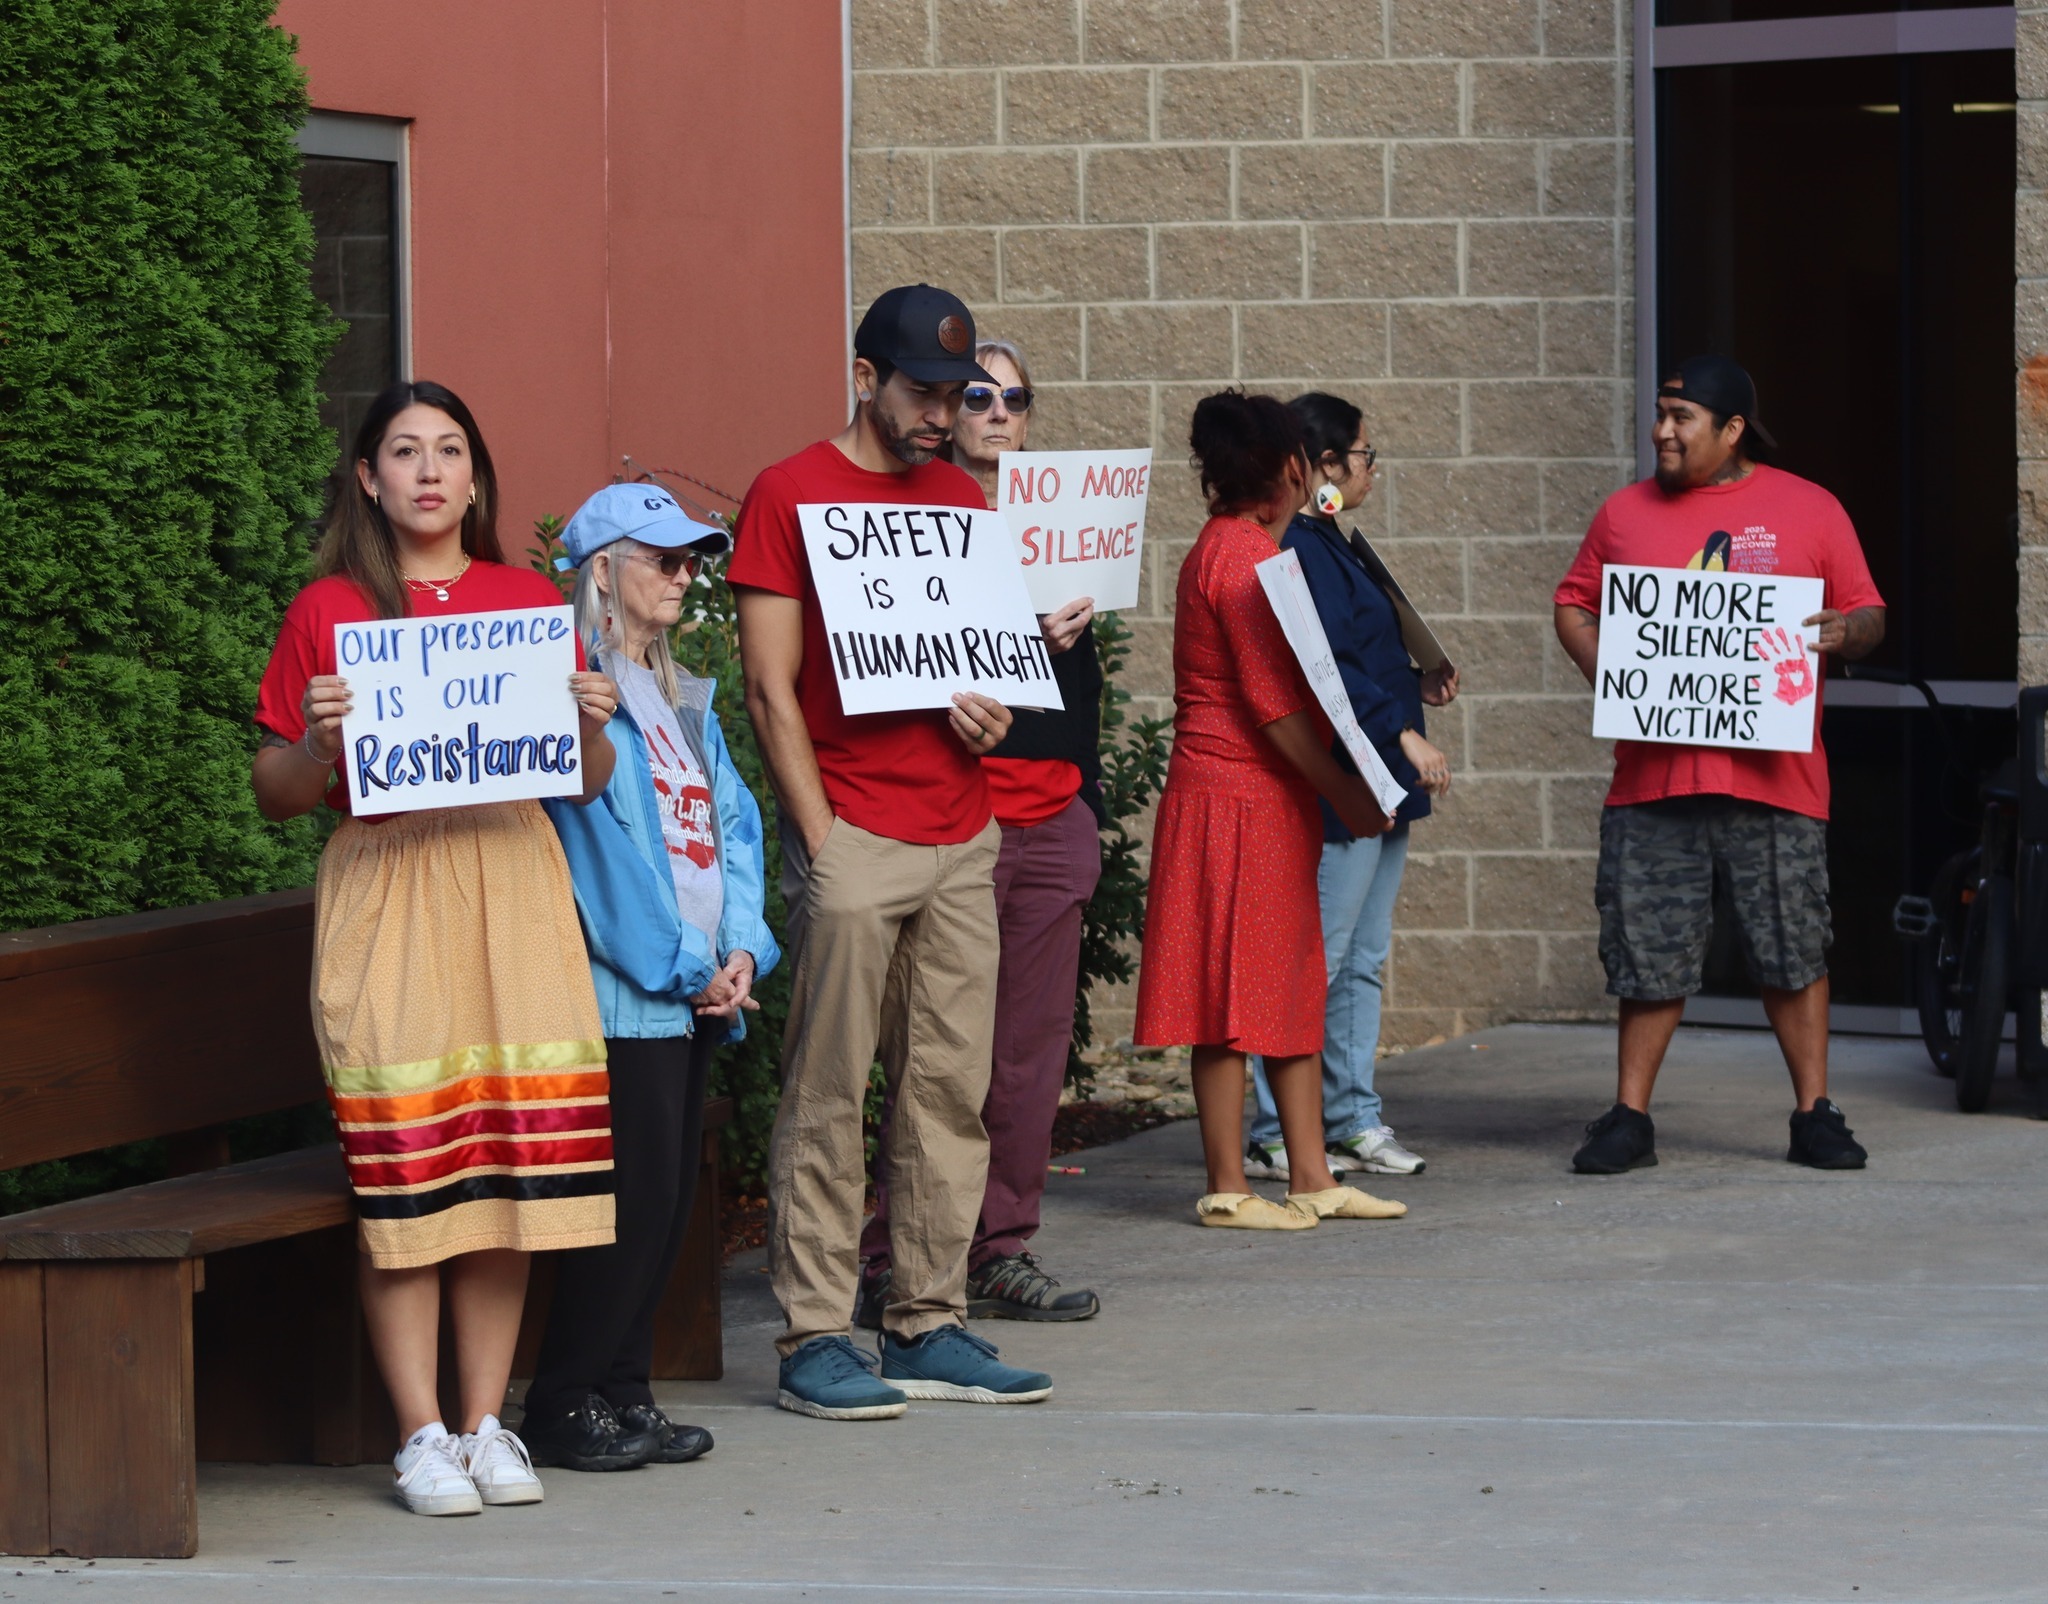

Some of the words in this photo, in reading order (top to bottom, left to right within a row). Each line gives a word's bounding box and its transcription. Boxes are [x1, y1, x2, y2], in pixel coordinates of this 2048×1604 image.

[1009, 466, 1060, 504] NO
[1081, 464, 1148, 499] MORE
[824, 506, 972, 560] SAFETY
[1021, 522, 1138, 566] SILENCE
[1731, 541, 1776, 550] RECOVERY
[1732, 534, 1756, 542] RALLY
[1759, 533, 1777, 541] FOR
[1753, 564, 1772, 573] YOU
[860, 571, 894, 609] is
[926, 575, 950, 605] a
[1608, 572, 1660, 618] NO
[1674, 580, 1776, 624] MORE
[421, 616, 570, 677] presence
[832, 630, 960, 680] HUMAN
[960, 627, 1051, 683] RIGHT
[1635, 621, 1763, 661] SILENCE
[376, 680, 404, 721] is
[443, 672, 517, 709] our
[1603, 669, 1648, 700] NO
[1668, 673, 1762, 705] MORE
[1633, 706, 1759, 742] VICTIMS.
[355, 722, 577, 798] Resistance
[662, 824, 703, 844] emember
